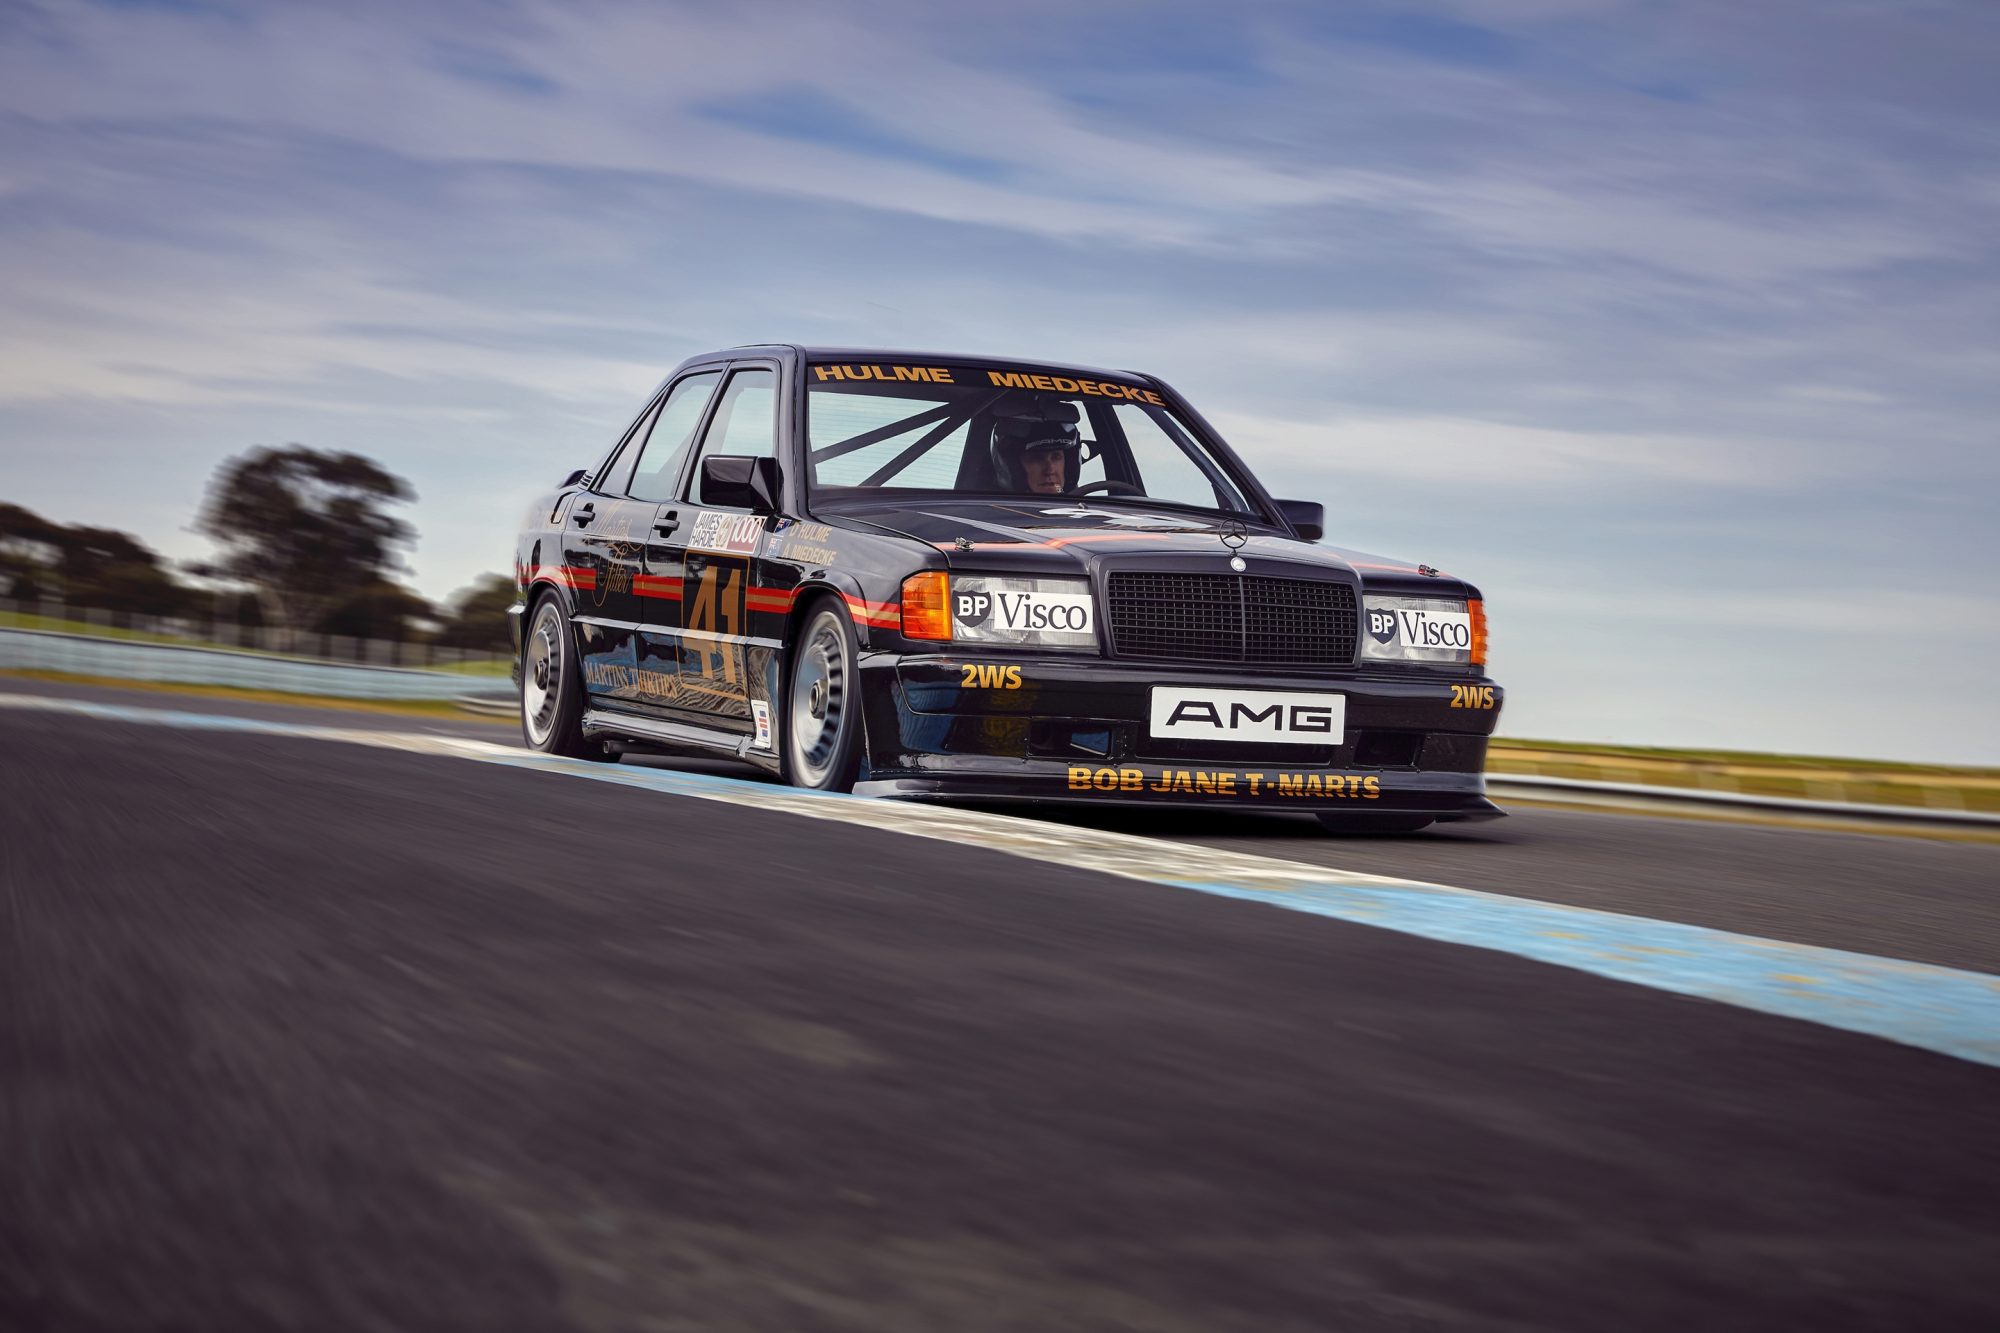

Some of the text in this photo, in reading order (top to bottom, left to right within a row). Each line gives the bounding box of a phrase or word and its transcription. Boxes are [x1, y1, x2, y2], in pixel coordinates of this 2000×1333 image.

[815, 365, 954, 383] HULME
[987, 371, 1167, 407] MIEDECKE
[695, 513, 723, 531] JAMES
[731, 515, 762, 545] 1000
[800, 522, 833, 543] HULME
[692, 529, 717, 548] HARDIE
[791, 544, 837, 567] MIEDECKE
[682, 565, 741, 684] 41
[957, 593, 1087, 631] BP Visco
[1370, 611, 1469, 647] BP Visco
[584, 661, 630, 689] MARTINS
[961, 663, 1022, 690] 2WS
[1450, 684, 1495, 710] 2WS
[1165, 700, 1333, 733] AMG
[1067, 767, 1145, 791] BOB
[1150, 770, 1238, 796] JANE
